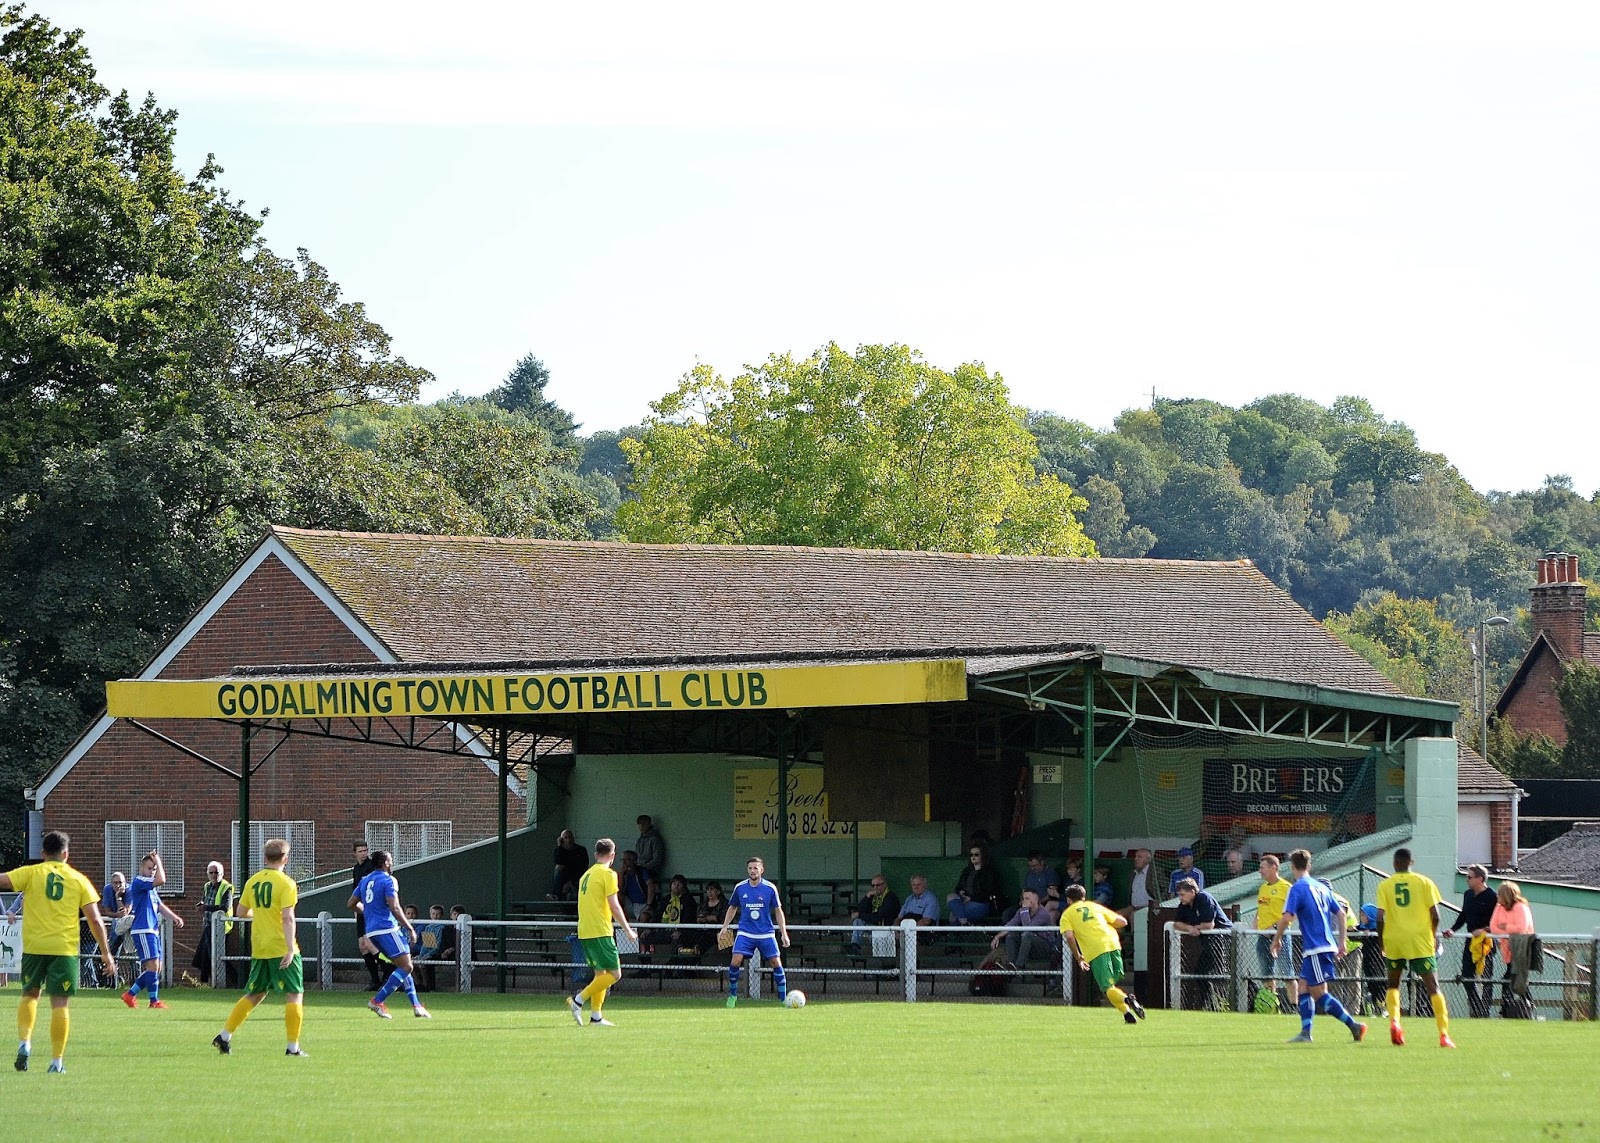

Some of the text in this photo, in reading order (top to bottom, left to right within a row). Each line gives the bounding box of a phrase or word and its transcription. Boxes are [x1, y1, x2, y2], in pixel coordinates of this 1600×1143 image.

[217, 672, 768, 715] GODALMING TOWN FOOTBALL CLUB
[1042, 774, 1053, 782] BOX
[1231, 763, 1344, 793] BREERS
[1246, 803, 1328, 813] DECORATING MATERIALS
[762, 812, 797, 835] 0143
[802, 812, 817, 835] 82
[45, 872, 65, 901] 6
[251, 881, 273, 909] 10
[581, 873, 589, 895] 4
[1395, 882, 1411, 908] 5
[1076, 906, 1095, 923] 2
